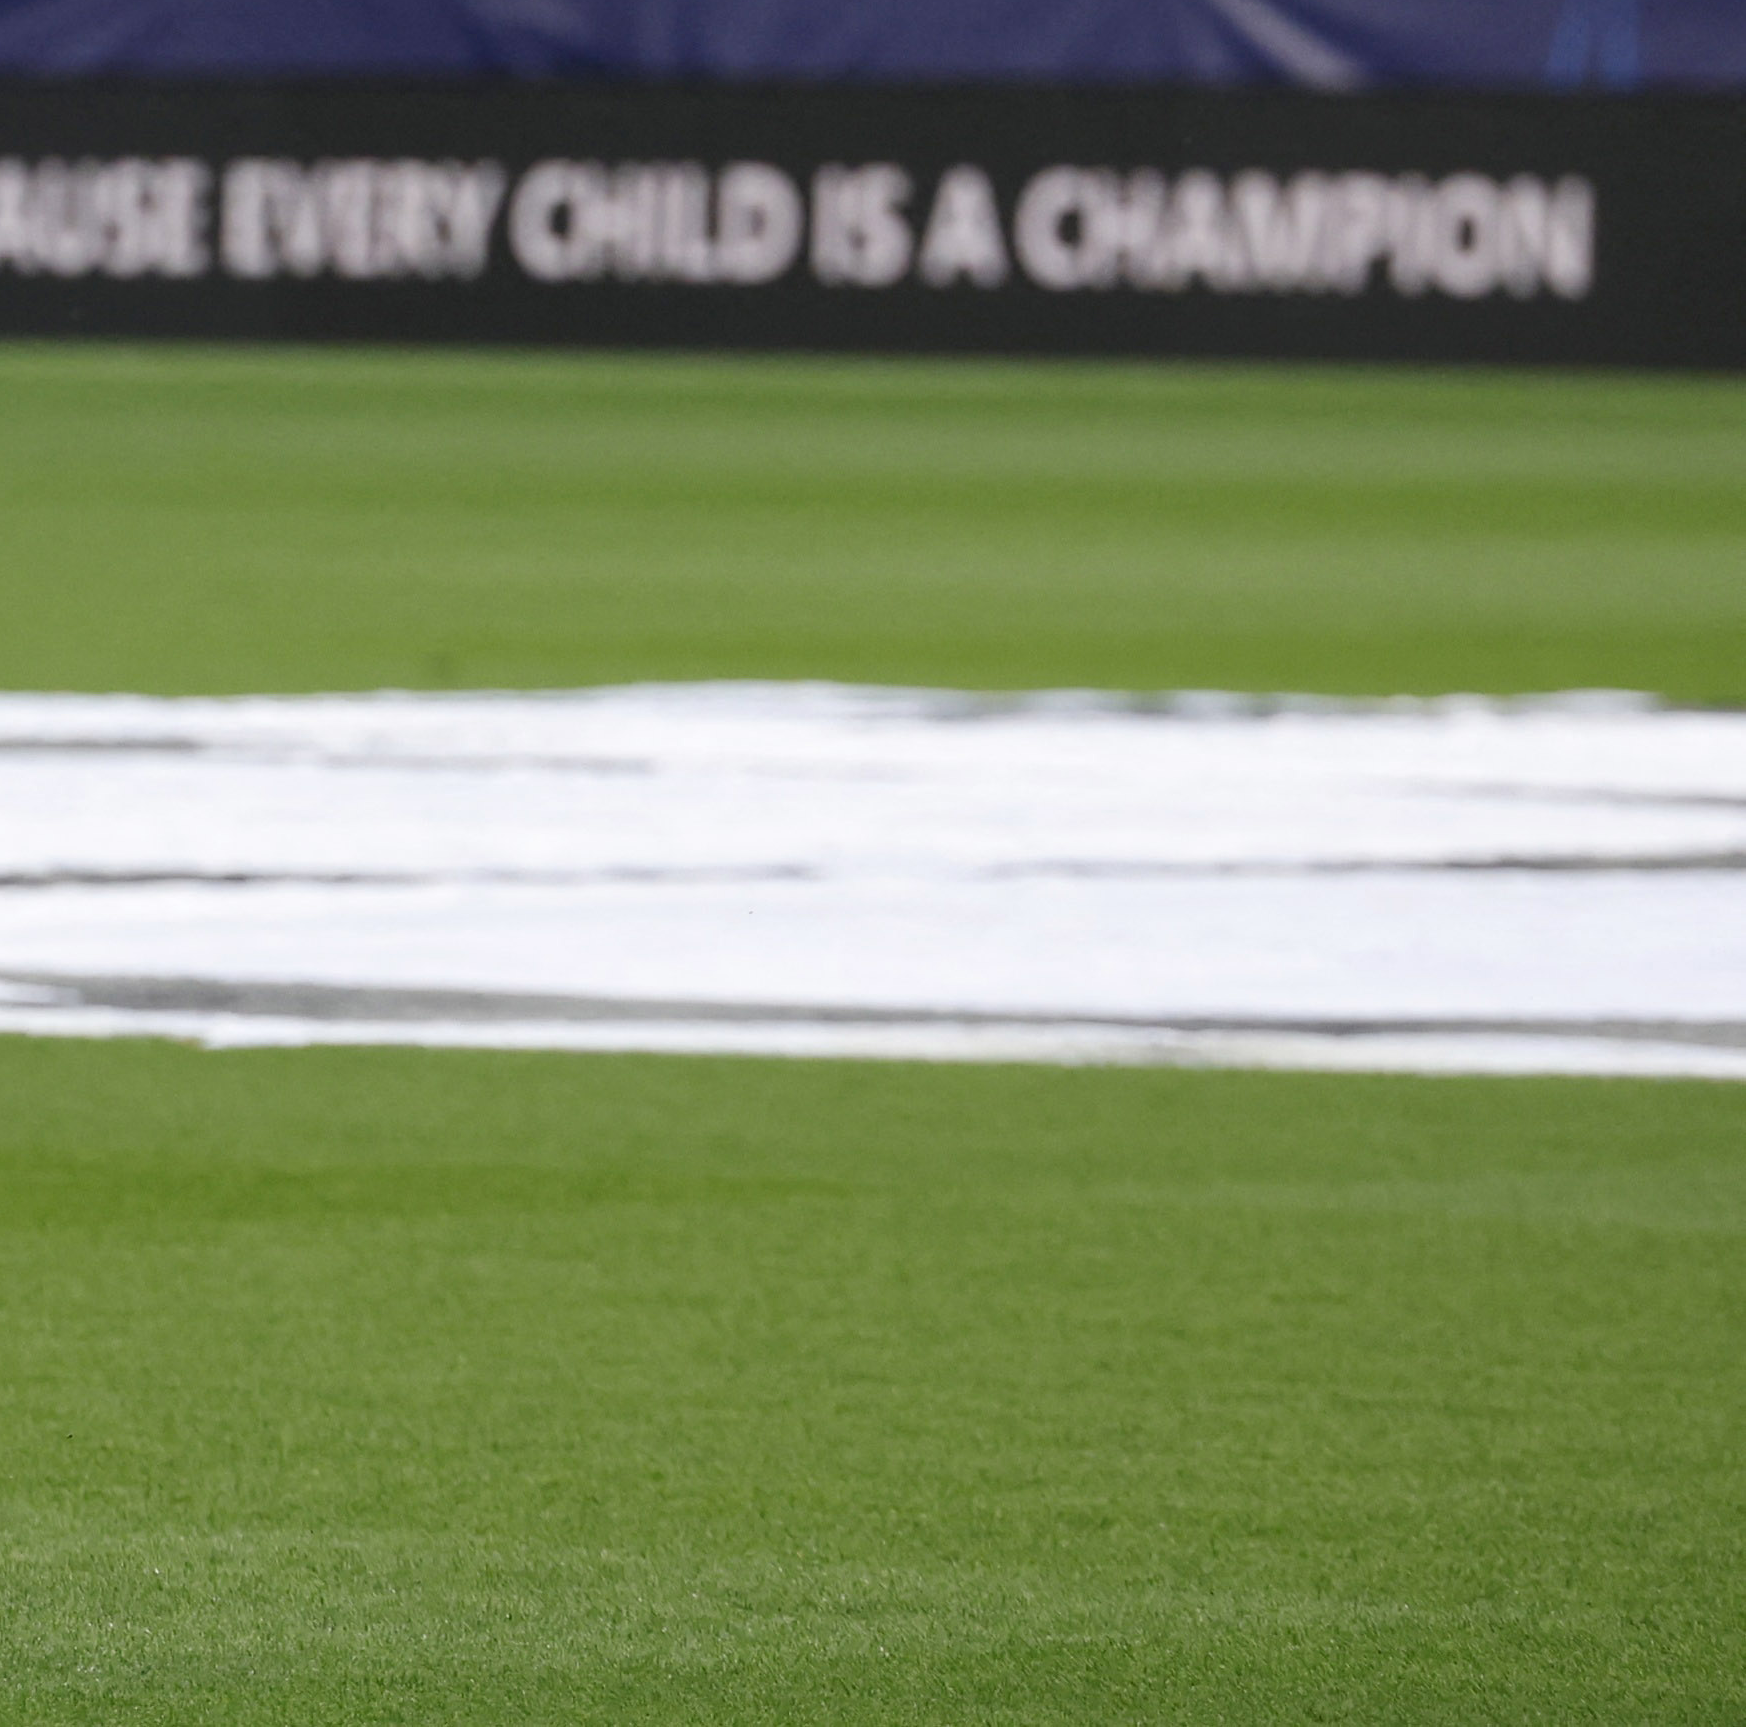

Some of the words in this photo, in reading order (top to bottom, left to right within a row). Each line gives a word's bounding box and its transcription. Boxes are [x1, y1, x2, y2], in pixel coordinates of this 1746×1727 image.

[219, 157, 506, 278] EVERY
[509, 159, 803, 283] CHILD
[809, 163, 913, 286] IS
[918, 165, 1007, 288] A
[1013, 167, 1594, 297] CHAMPION
